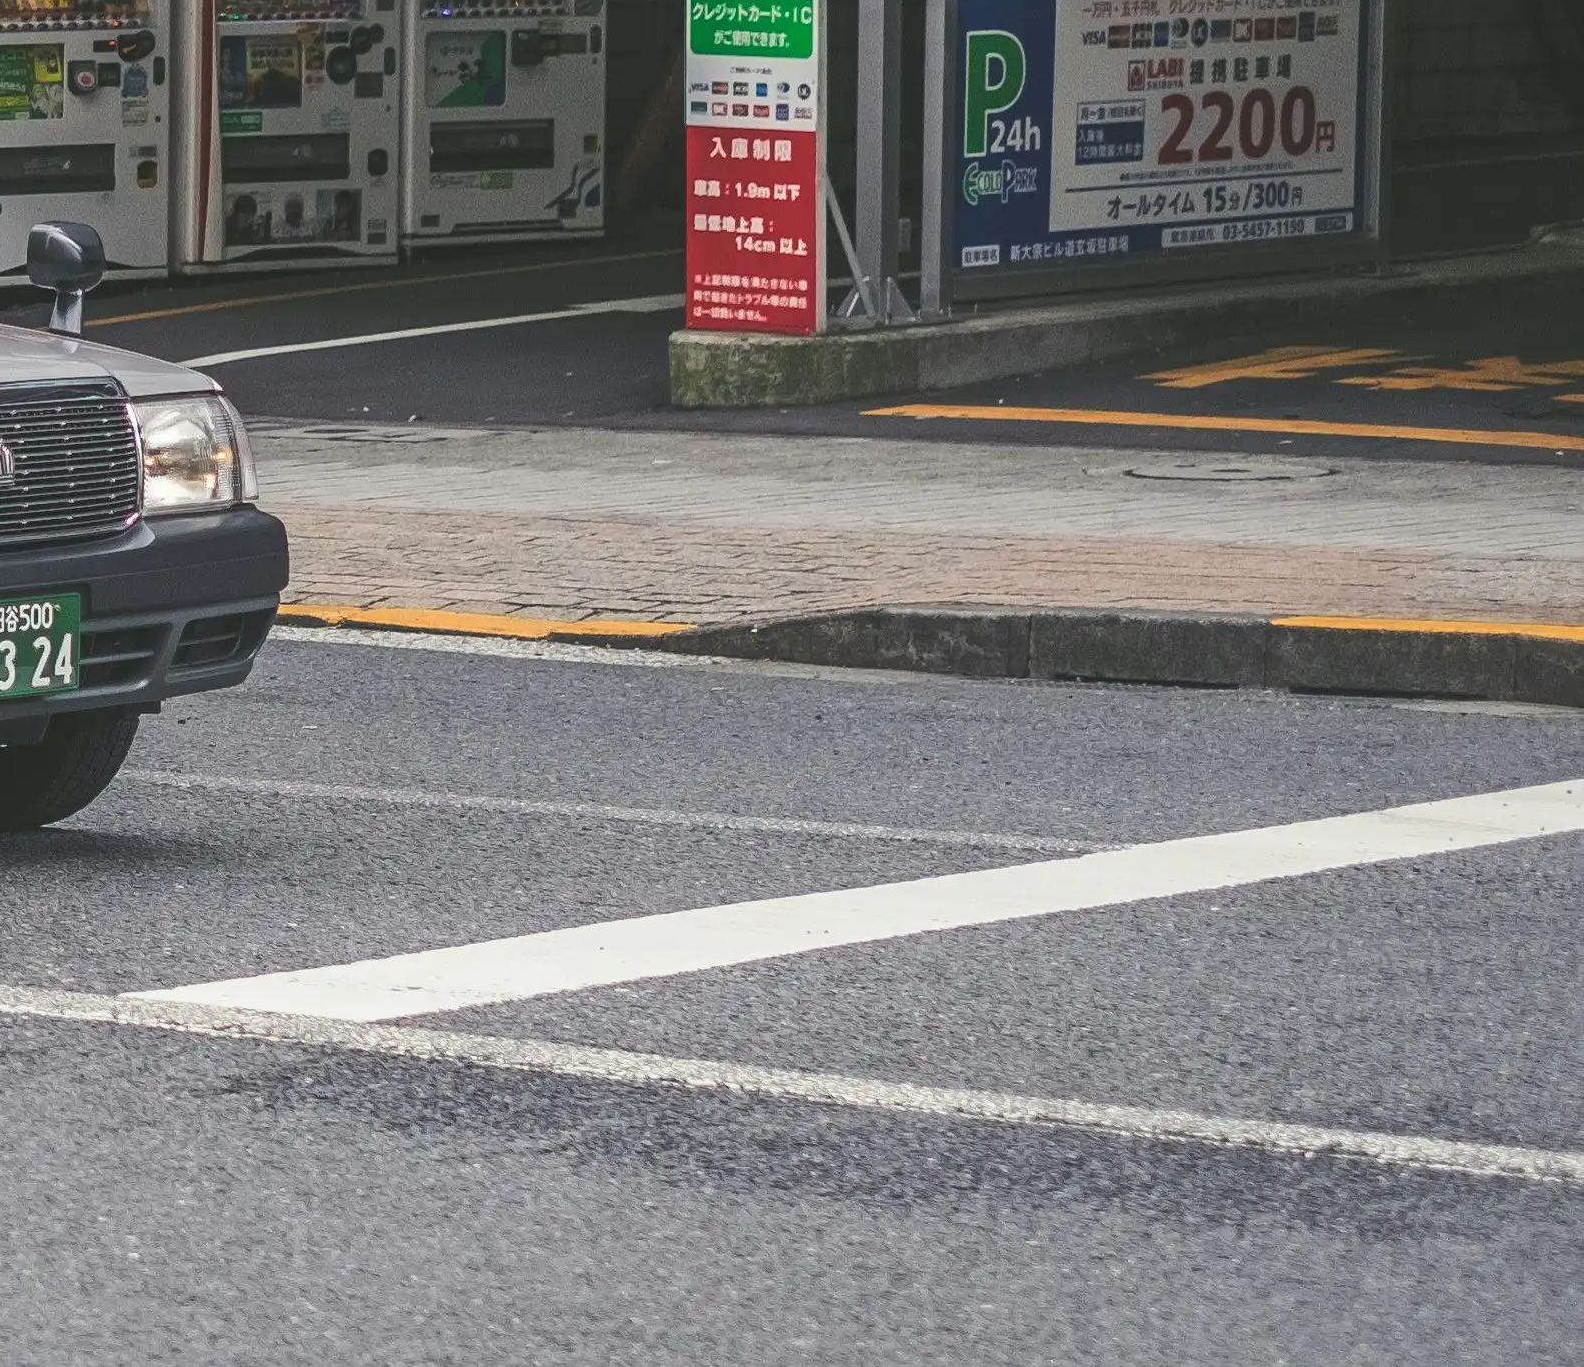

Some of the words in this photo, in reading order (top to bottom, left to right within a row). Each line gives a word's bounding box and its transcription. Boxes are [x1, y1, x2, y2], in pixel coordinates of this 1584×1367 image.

[1146, 58, 1184, 79] LABI
[964, 30, 1026, 157] P
[991, 116, 1041, 154] 24h
[1107, 191, 1196, 220] オールタイム
